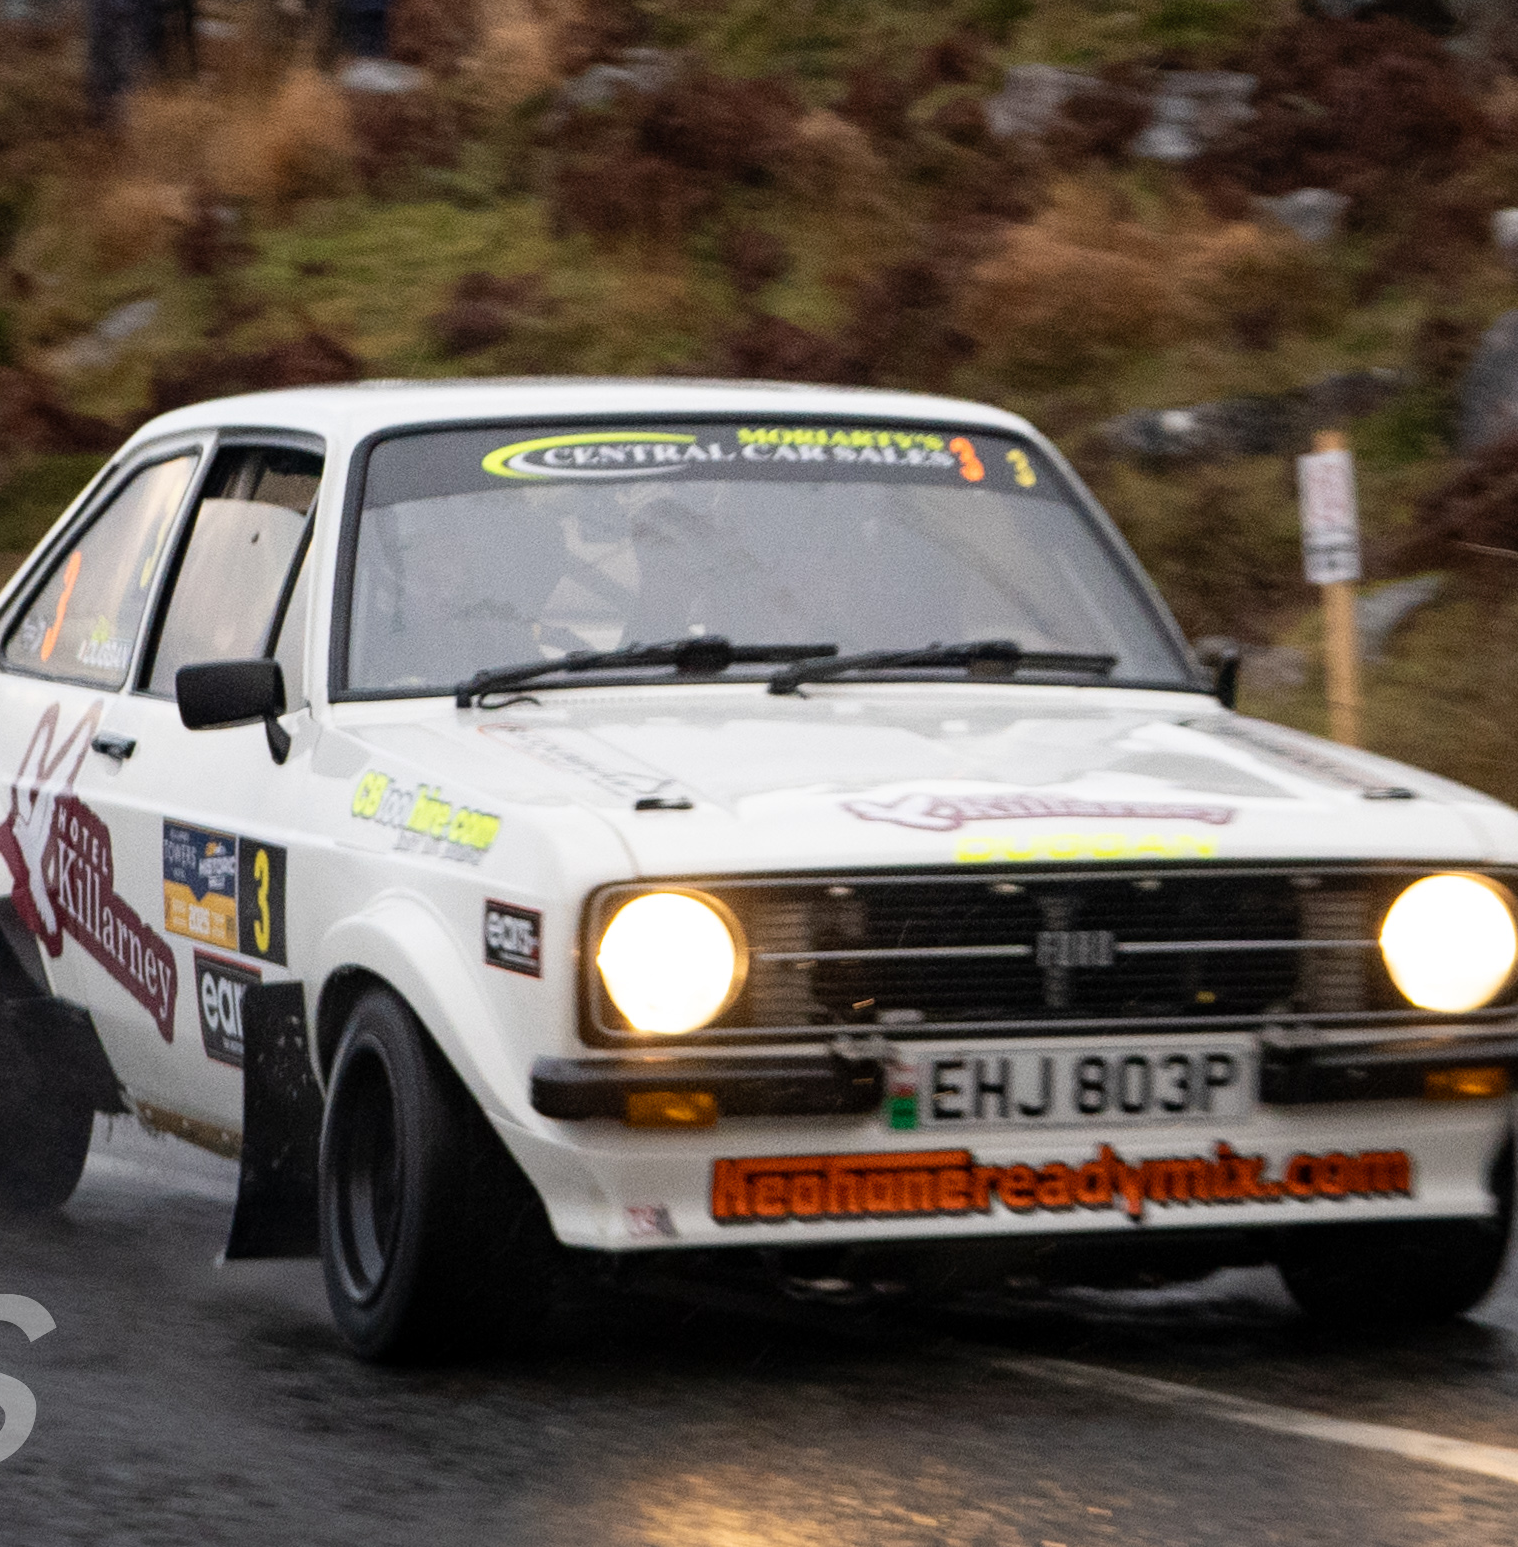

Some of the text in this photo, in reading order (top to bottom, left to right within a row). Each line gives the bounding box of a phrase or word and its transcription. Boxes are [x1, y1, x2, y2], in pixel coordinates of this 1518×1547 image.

[543, 443, 955, 468] CENTRAL CAR SALES
[737, 427, 945, 450] MORIARTY'S
[948, 436, 986, 483] 3
[1005, 448, 1038, 488] 3
[40, 550, 82, 662] 3
[57, 805, 110, 877] HOTEL
[57, 837, 173, 1021] Killarney
[253, 848, 271, 954] 3
[932, 1051, 1238, 1121] EHJ 803P
